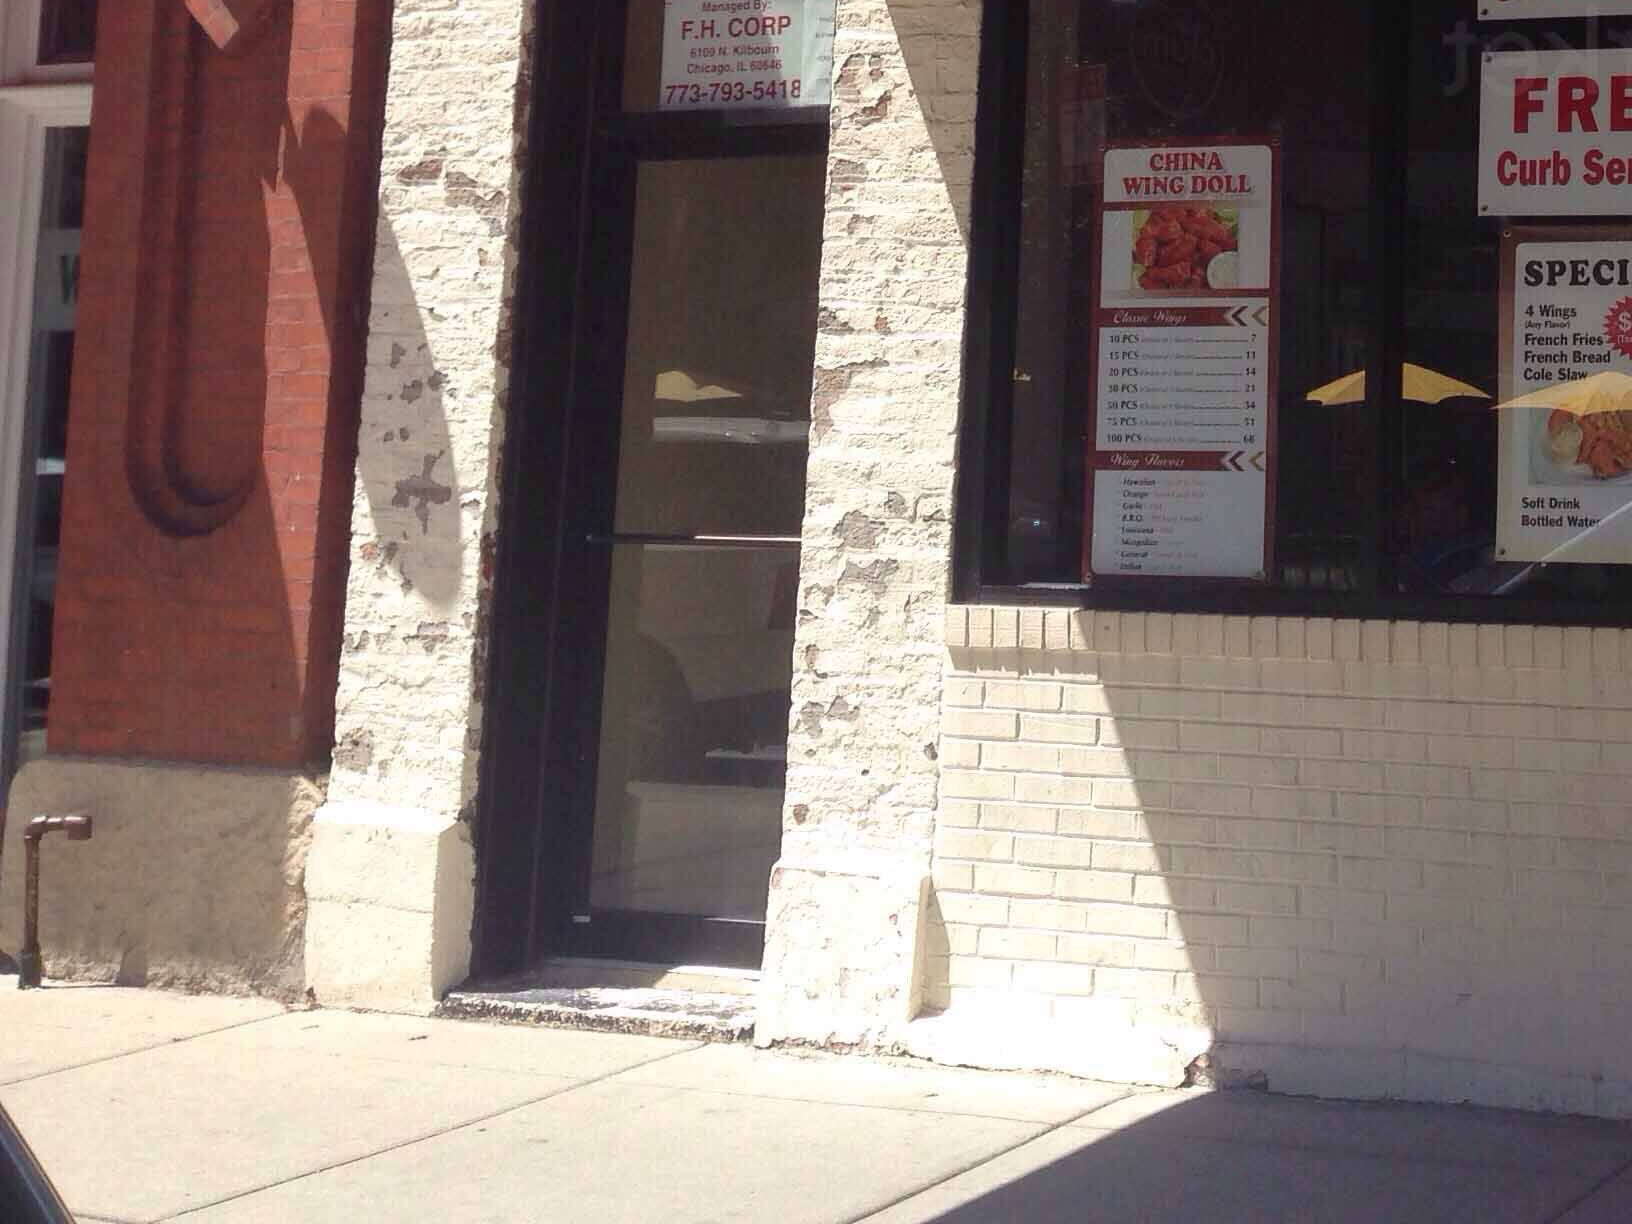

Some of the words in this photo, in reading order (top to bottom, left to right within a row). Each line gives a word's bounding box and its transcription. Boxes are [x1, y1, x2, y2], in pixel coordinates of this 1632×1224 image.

[702, 0, 750, 14] Managed
[681, 20, 720, 40] F.H.
[729, 16, 791, 37] CORP
[665, 80, 800, 104] 773-793-5418
[1150, 151, 1223, 171] CHINA
[1497, 150, 1571, 186] Curb
[1123, 177, 1184, 195] WING
[1190, 174, 1251, 194] DOLL
[1525, 305, 1534, 317] 4
[1540, 304, 1577, 319] Wings
[1524, 333, 1567, 347] French
[1573, 333, 1604, 346] Fries
[1524, 350, 1567, 364] French
[1573, 350, 1611, 364] Bread
[1523, 368, 1552, 381] Cole
[1558, 368, 1588, 381] Slaw
[1521, 497, 1544, 509] Soft
[1549, 497, 1580, 509] Drink
[1521, 515, 1563, 527] Bottled
[1567, 515, 1602, 528] Water
